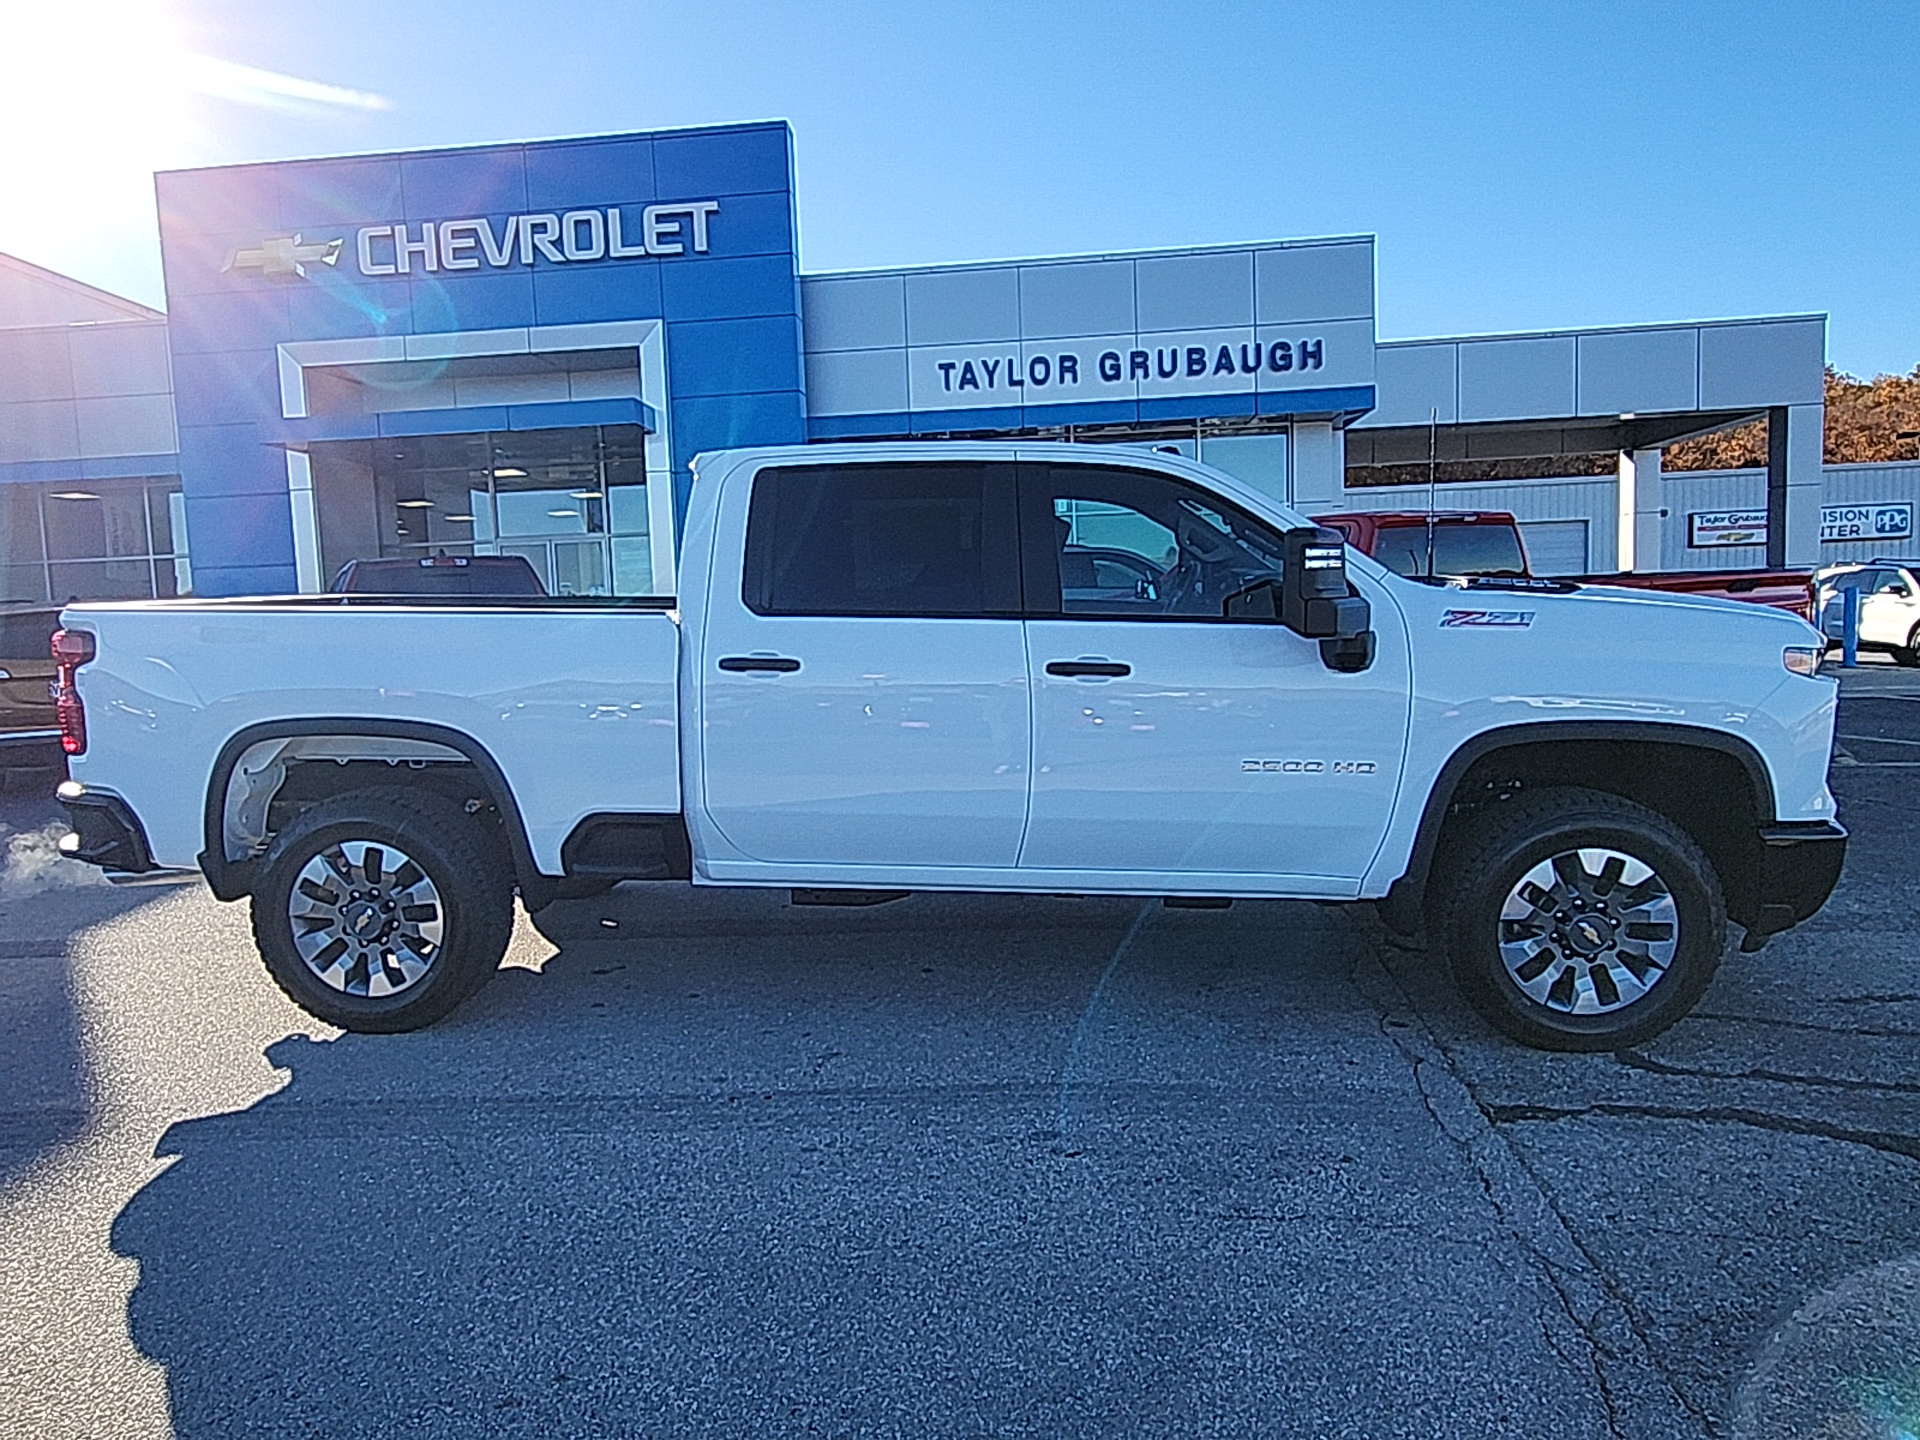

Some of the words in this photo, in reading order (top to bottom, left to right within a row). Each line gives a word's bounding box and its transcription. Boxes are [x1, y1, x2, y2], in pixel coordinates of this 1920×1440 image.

[356, 200, 719, 276] CHEVROLET
[938, 355, 1079, 391] TAYLOR
[1099, 339, 1324, 382] GRUBAUGH
[1698, 515, 1727, 526] Taylor
[1877, 511, 1907, 531] PPG
[1439, 609, 1536, 628] Z71
[1242, 760, 1325, 772] 2500
[1333, 762, 1376, 774] HD
